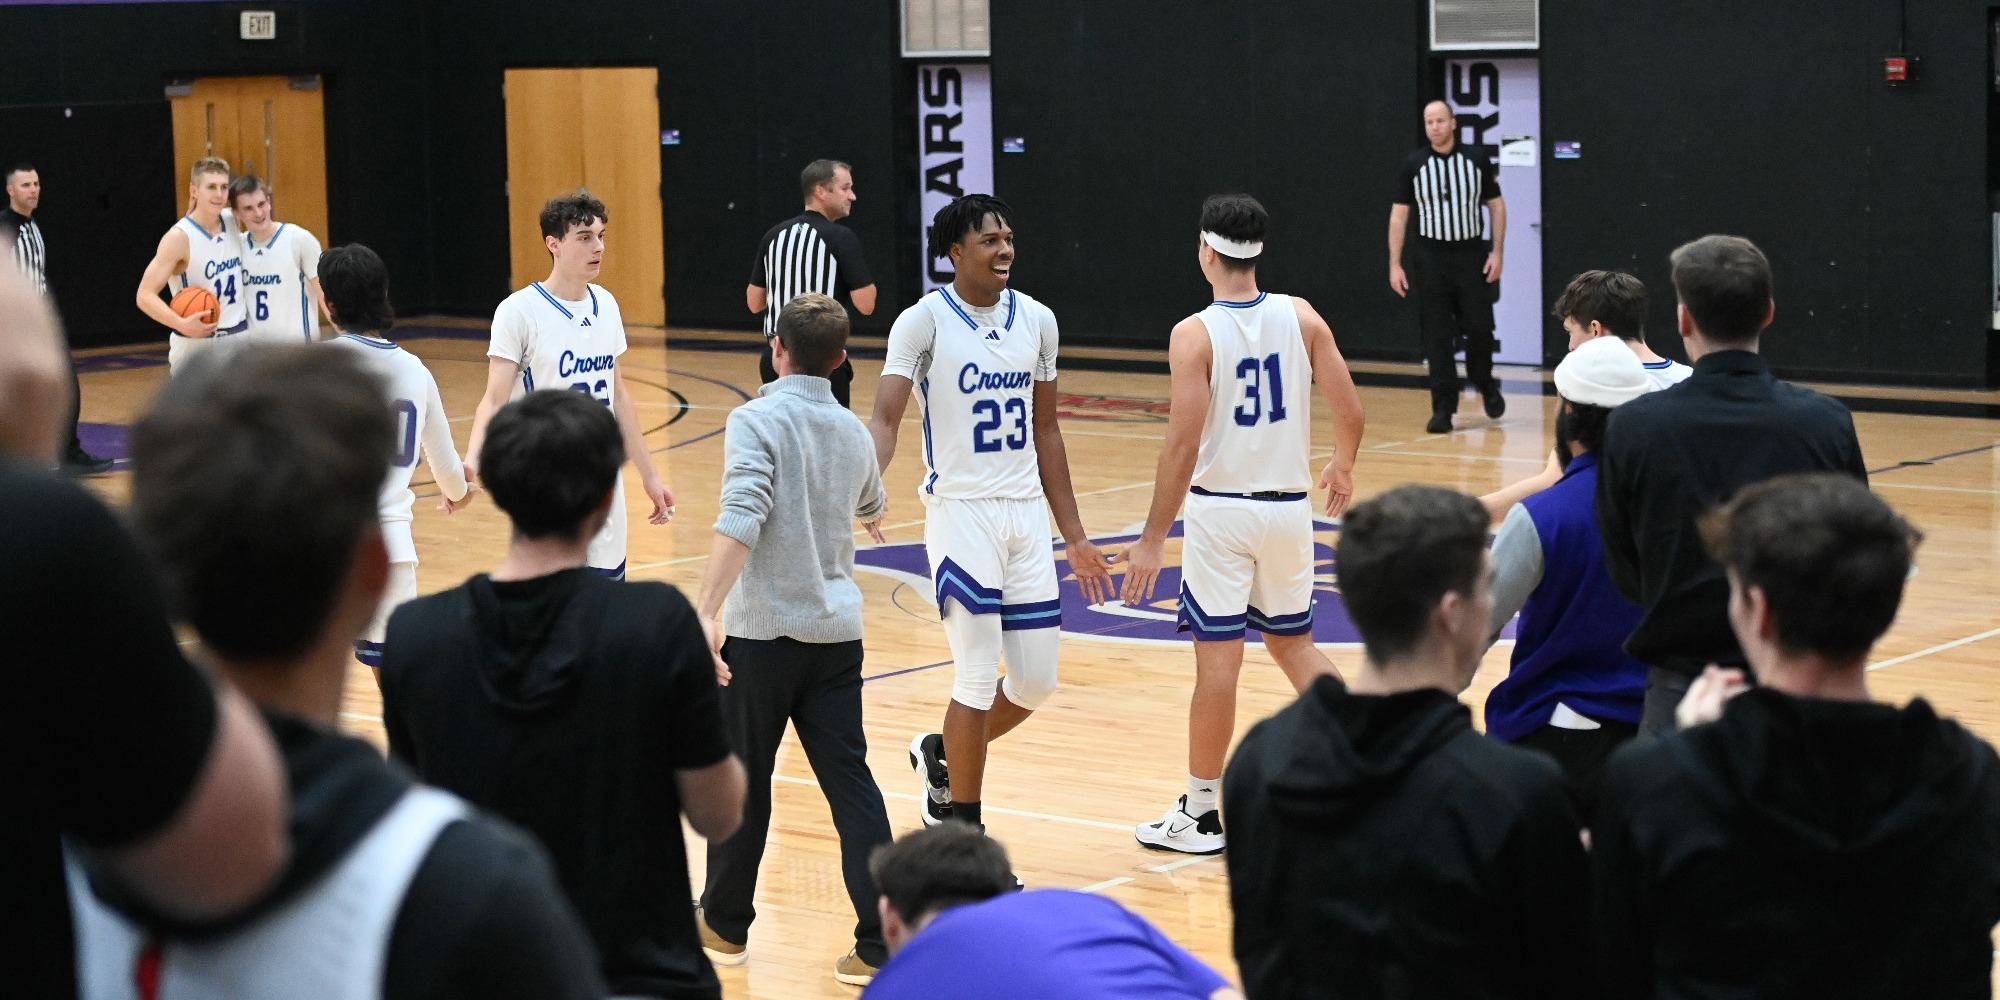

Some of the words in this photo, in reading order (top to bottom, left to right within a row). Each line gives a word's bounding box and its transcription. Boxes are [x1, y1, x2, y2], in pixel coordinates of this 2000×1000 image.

[250, 15, 271, 36] EXIT
[205, 256, 241, 280] Crown
[242, 269, 281, 286] Crown
[214, 274, 236, 305] 14
[256, 290, 269, 321] 6
[559, 350, 614, 378] Crown
[958, 362, 1031, 394] Crown
[1233, 352, 1287, 427] 31
[391, 398, 417, 468] 0
[972, 397, 1027, 453] 23
